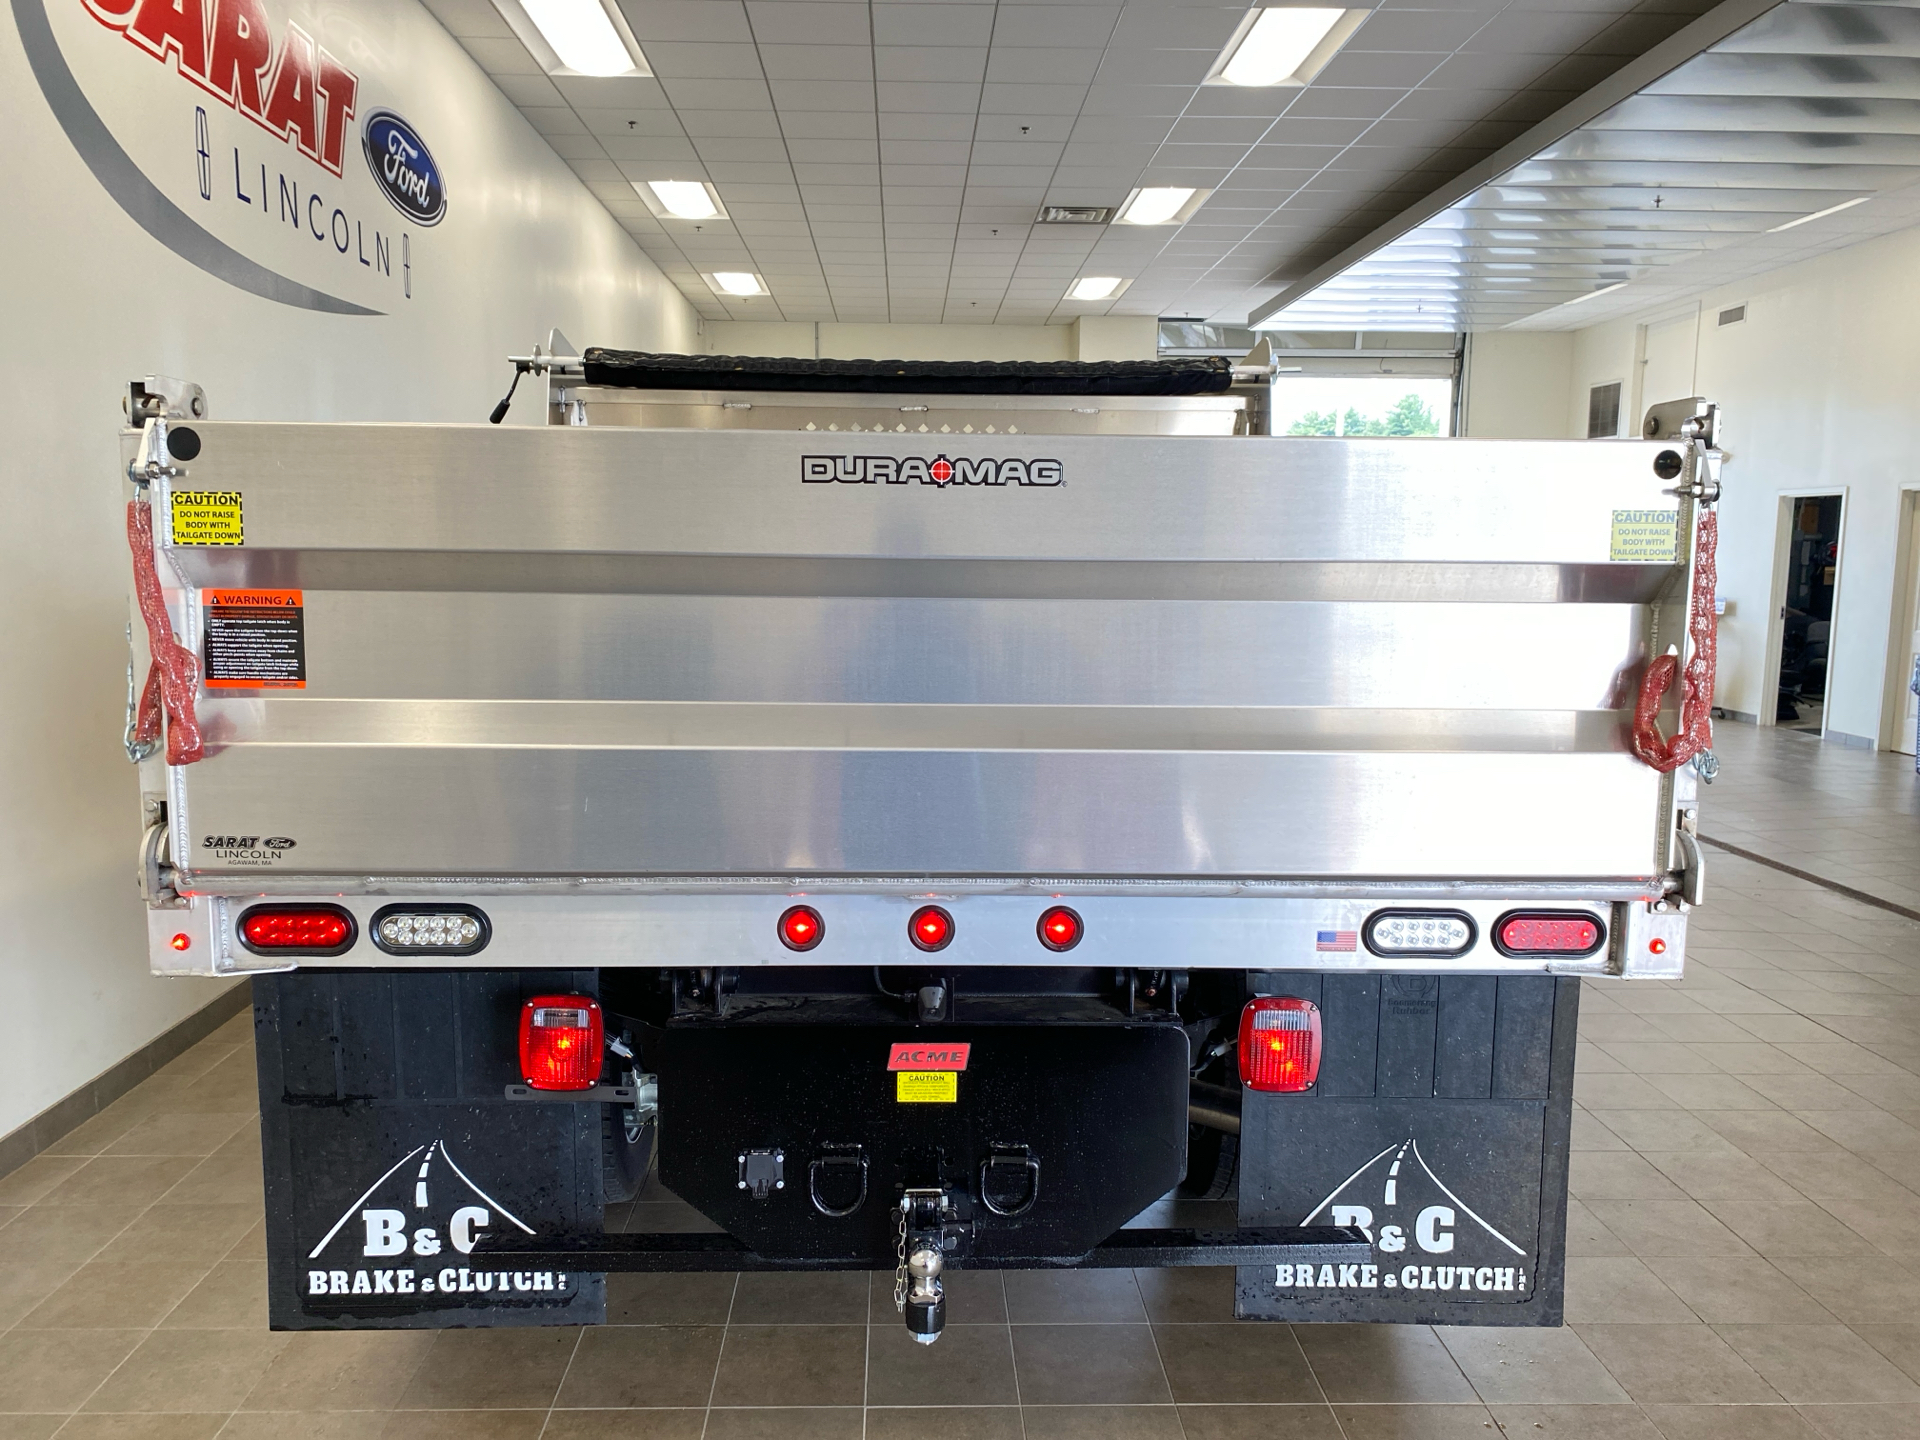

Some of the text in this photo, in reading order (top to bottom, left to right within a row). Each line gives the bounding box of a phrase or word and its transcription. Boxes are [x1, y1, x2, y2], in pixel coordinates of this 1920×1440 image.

[383, 129, 431, 209] Ford
[233, 146, 391, 278] LINCOLN
[174, 494, 238, 505] CAUTION
[179, 510, 235, 519] DO NOT RAISE
[1614, 512, 1676, 523] CAUTION
[185, 521, 231, 529] BODY WITH
[176, 531, 241, 540] TAILGATE DOWN
[1618, 528, 1671, 536] DO NOT RAISE
[1622, 538, 1665, 546] BODY WITH
[1613, 548, 1674, 556] TAILGATE DOWN
[223, 595, 282, 605] WARNING
[202, 835, 291, 850] SARAT Ford
[216, 849, 282, 859] LINCOLN
[894, 1050, 965, 1063] ACME
[308, 1268, 554, 1294] BRAKE & CLUTCH
[1274, 1263, 1516, 1291] BRAKE & CLUTCH
